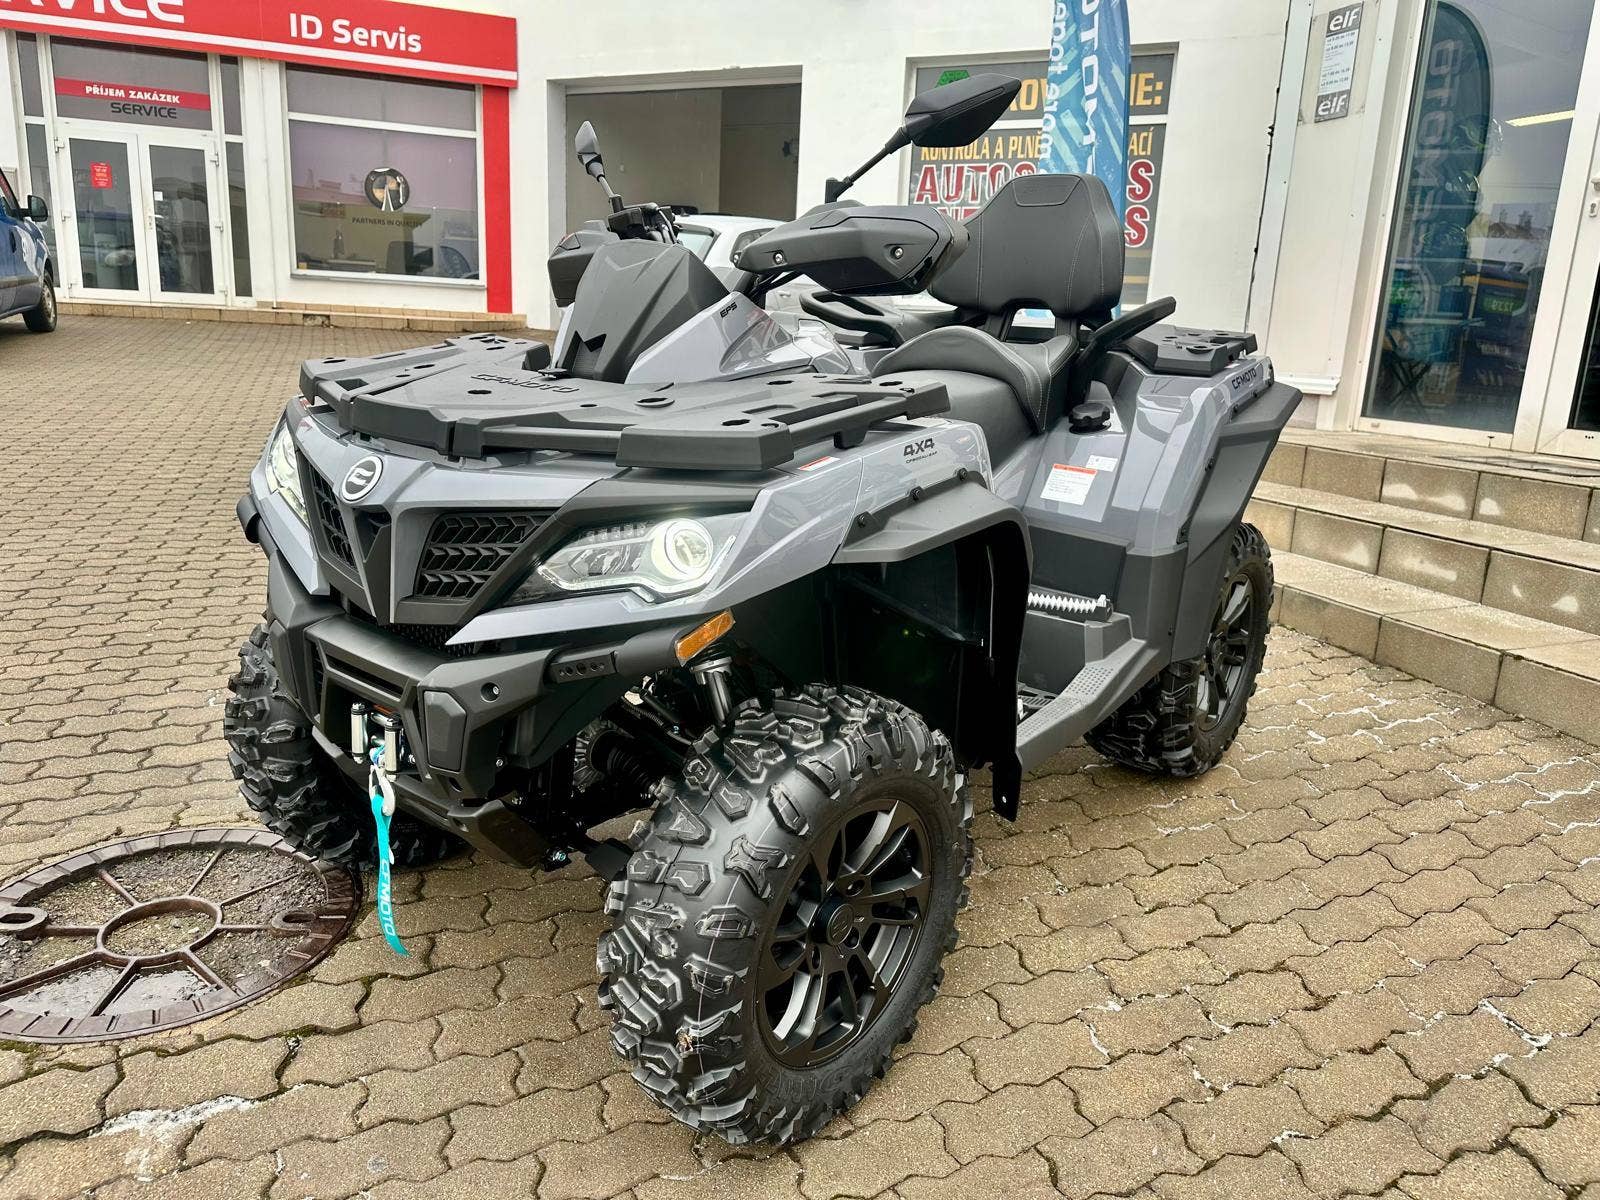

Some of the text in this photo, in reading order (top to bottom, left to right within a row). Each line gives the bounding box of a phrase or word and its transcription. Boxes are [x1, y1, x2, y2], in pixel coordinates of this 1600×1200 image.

[1329, 7, 1360, 31] elf
[289, 12, 422, 53] ID Servis
[85, 84, 180, 104] PŘÍJEM ZAKÁZEK
[1318, 94, 1347, 116] elf
[110, 102, 177, 119] SERVICE
[720, 301, 738, 318] EPS
[1231, 367, 1257, 390] CFMOTO
[380, 859, 396, 936] CFMOTO
